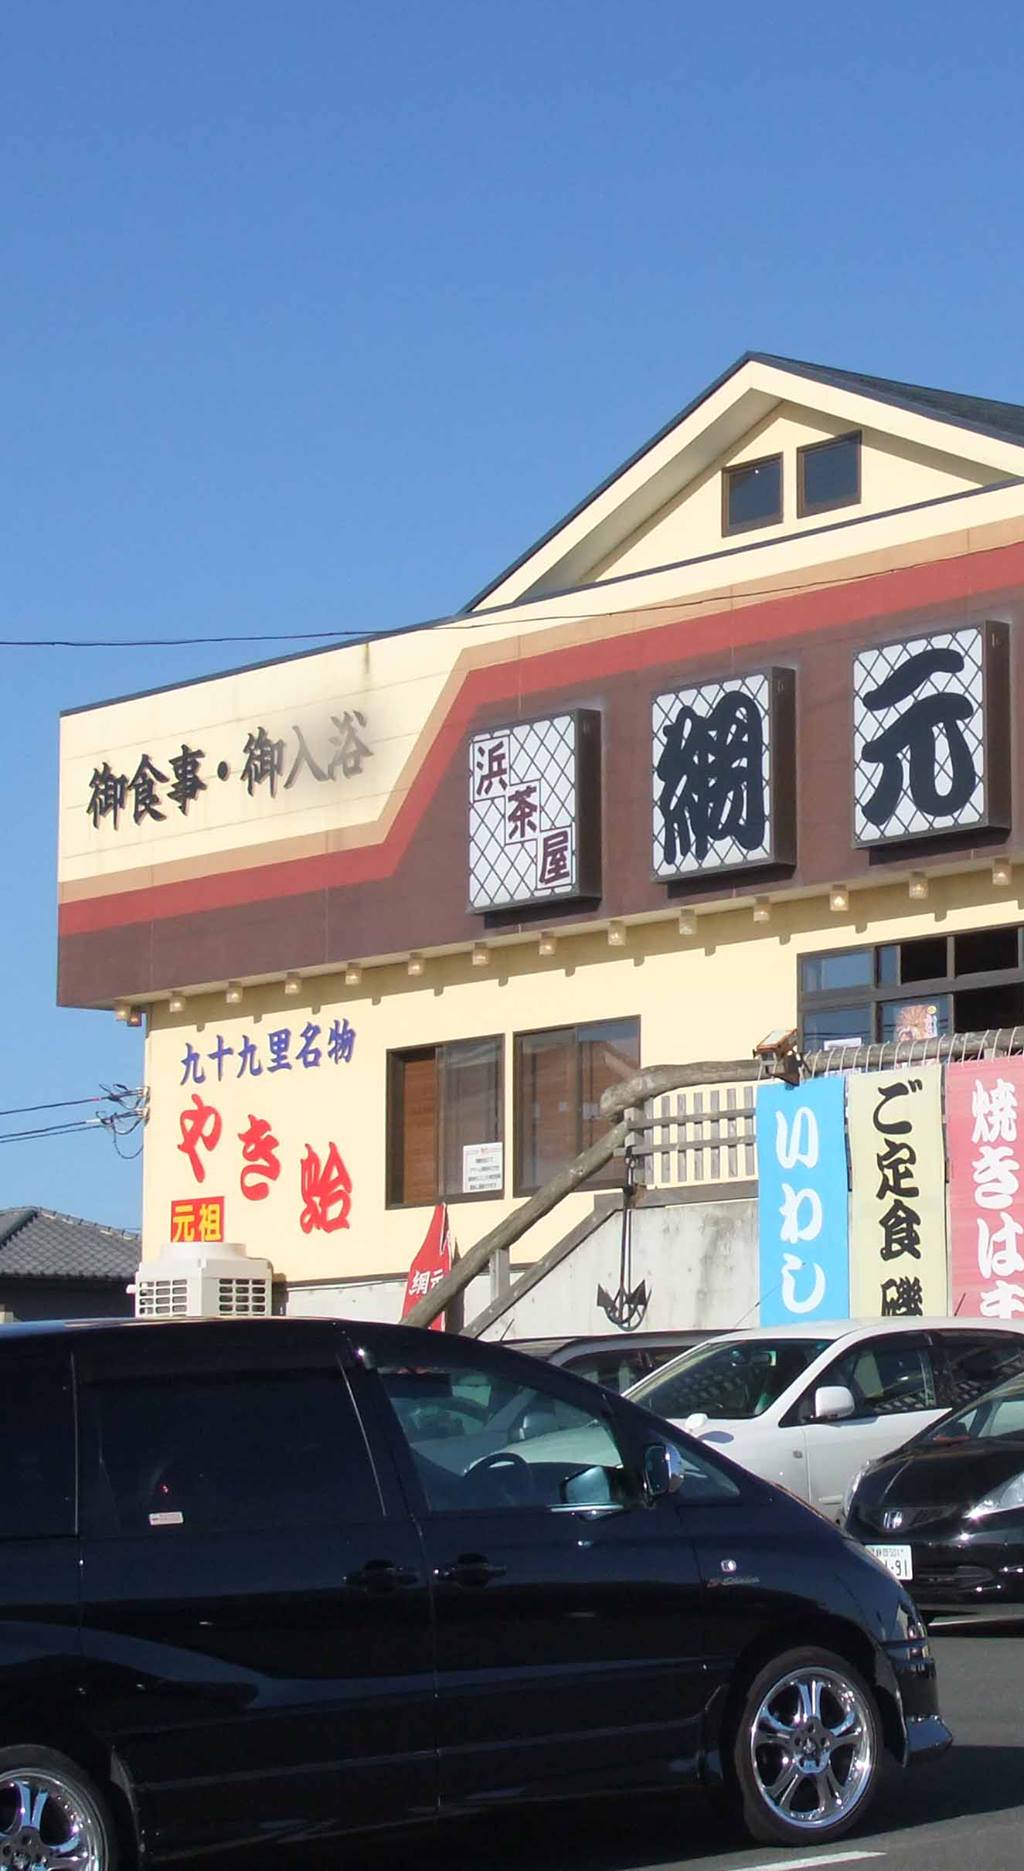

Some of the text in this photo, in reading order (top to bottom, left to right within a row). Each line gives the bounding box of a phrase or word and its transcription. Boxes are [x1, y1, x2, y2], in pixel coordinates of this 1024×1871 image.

[476, 740, 571, 886] 浜茶屋
[179, 1018, 357, 1086] 九十九里名物
[172, 1204, 222, 1243] 元祖
[775, 1106, 826, 1314] いわし
